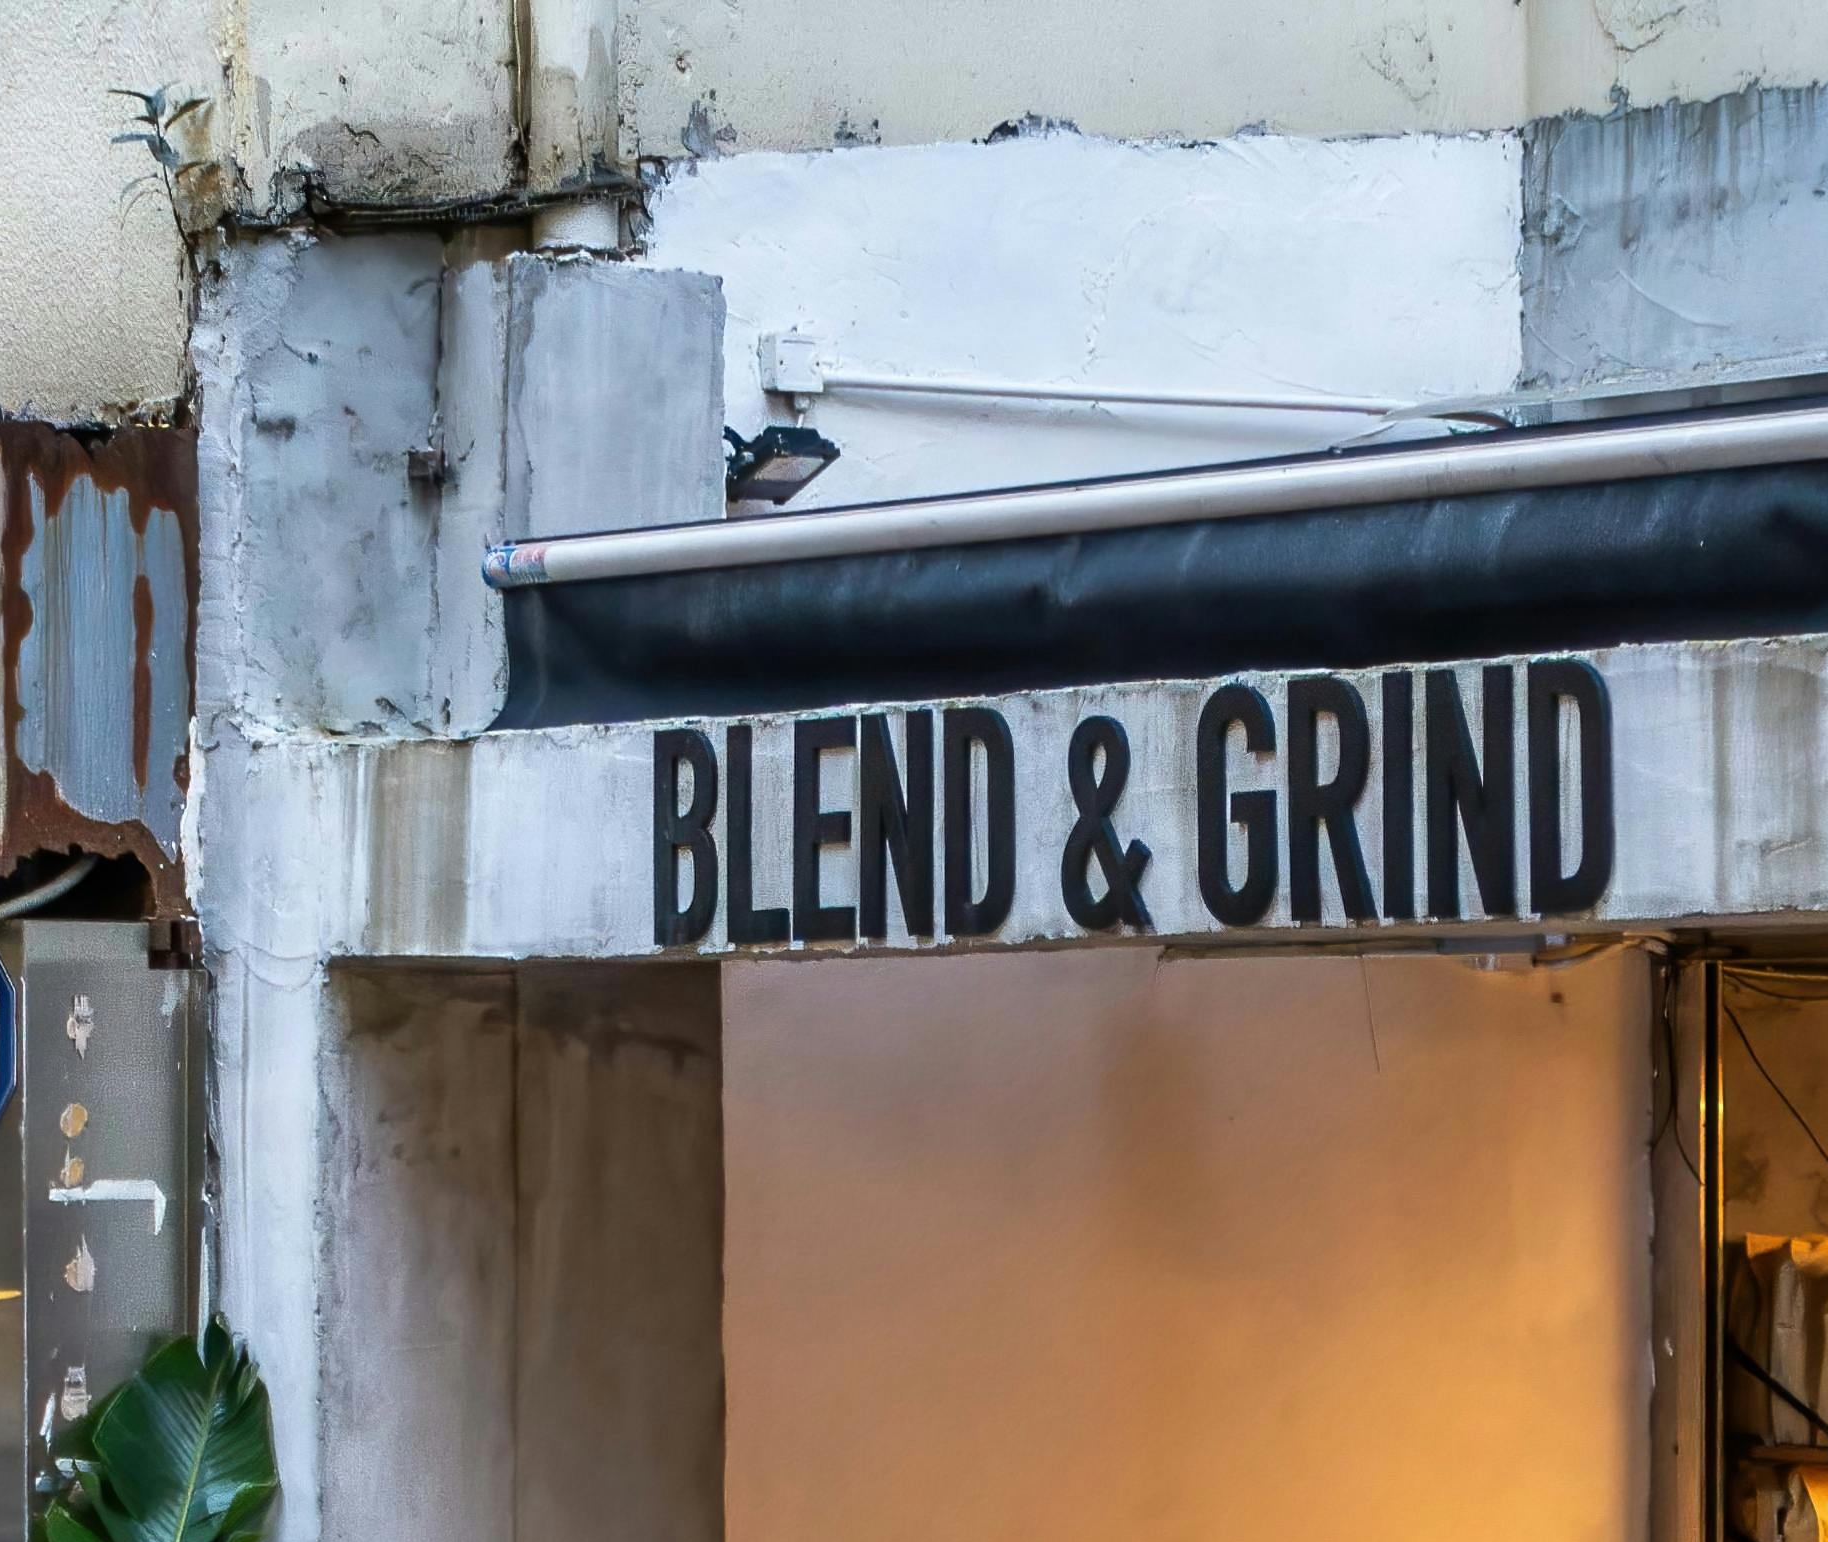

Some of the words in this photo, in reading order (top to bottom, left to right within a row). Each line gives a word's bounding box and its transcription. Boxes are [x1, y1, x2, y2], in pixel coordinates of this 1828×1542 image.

[653, 706, 1017, 946] BLEND
[1060, 714, 1153, 932] &
[1197, 657, 1614, 927] GRIND
